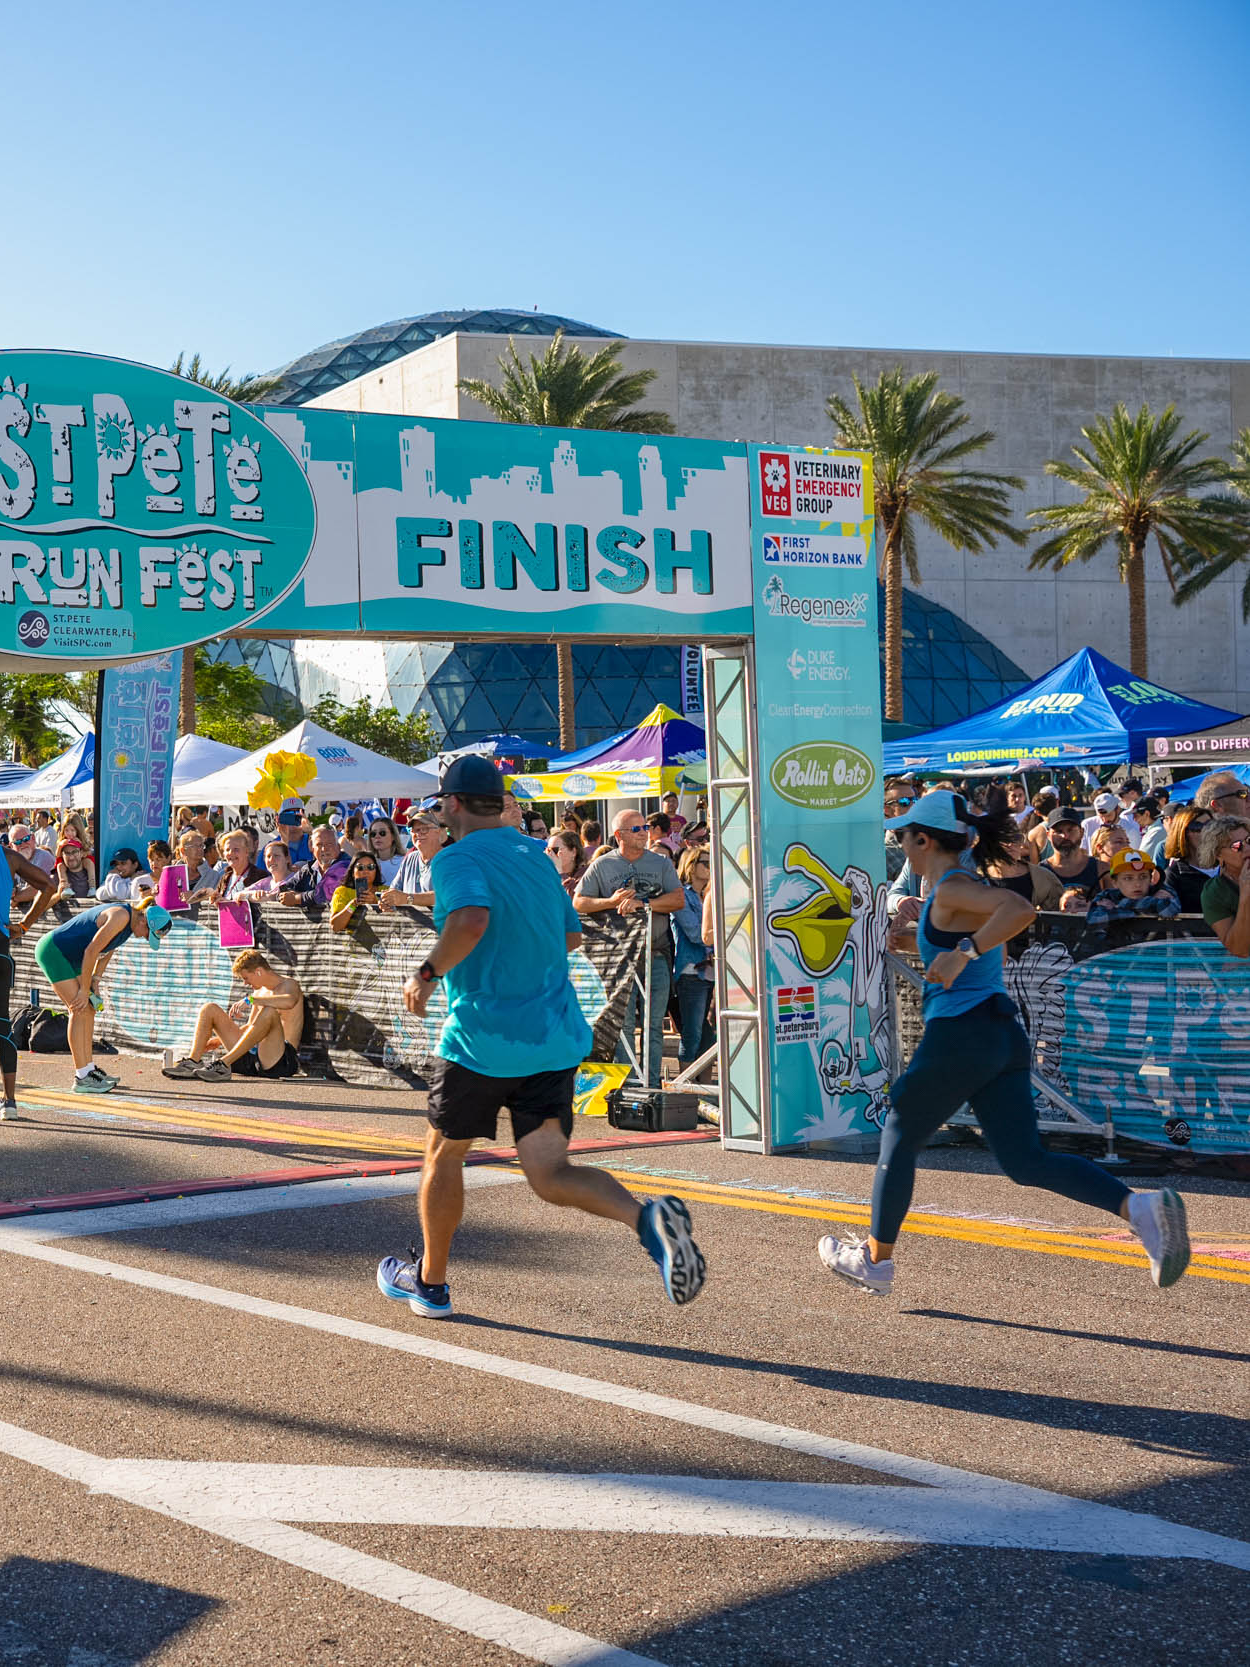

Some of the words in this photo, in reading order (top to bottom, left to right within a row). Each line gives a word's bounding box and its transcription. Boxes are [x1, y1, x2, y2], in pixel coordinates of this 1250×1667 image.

[794, 460, 861, 481] VETERINARY
[795, 478, 862, 498] EMERGENCY
[765, 494, 789, 511] VEG
[796, 497, 833, 514] GROUP
[782, 536, 810, 549] FIRST
[395, 515, 714, 595] FINISH
[783, 551, 829, 563] HORIZON
[833, 553, 863, 565] BANK
[53, 638, 112, 648] VisitSPC.com
[808, 650, 835, 665] DUKE
[808, 667, 849, 681] ENERGY
[1174, 740, 1193, 752] DO
[1196, 740, 1208, 751] IT
[947, 747, 1059, 763] LOUDRUNNERS.COM
[780, 760, 830, 787] Rollin'
[833, 759, 866, 786] Oats
[146, 759, 167, 829] RUN
[810, 798, 838, 806] MARKET
[775, 1021, 819, 1034] st.petersburg
[776, 1032, 819, 1042] www.stpete.org
